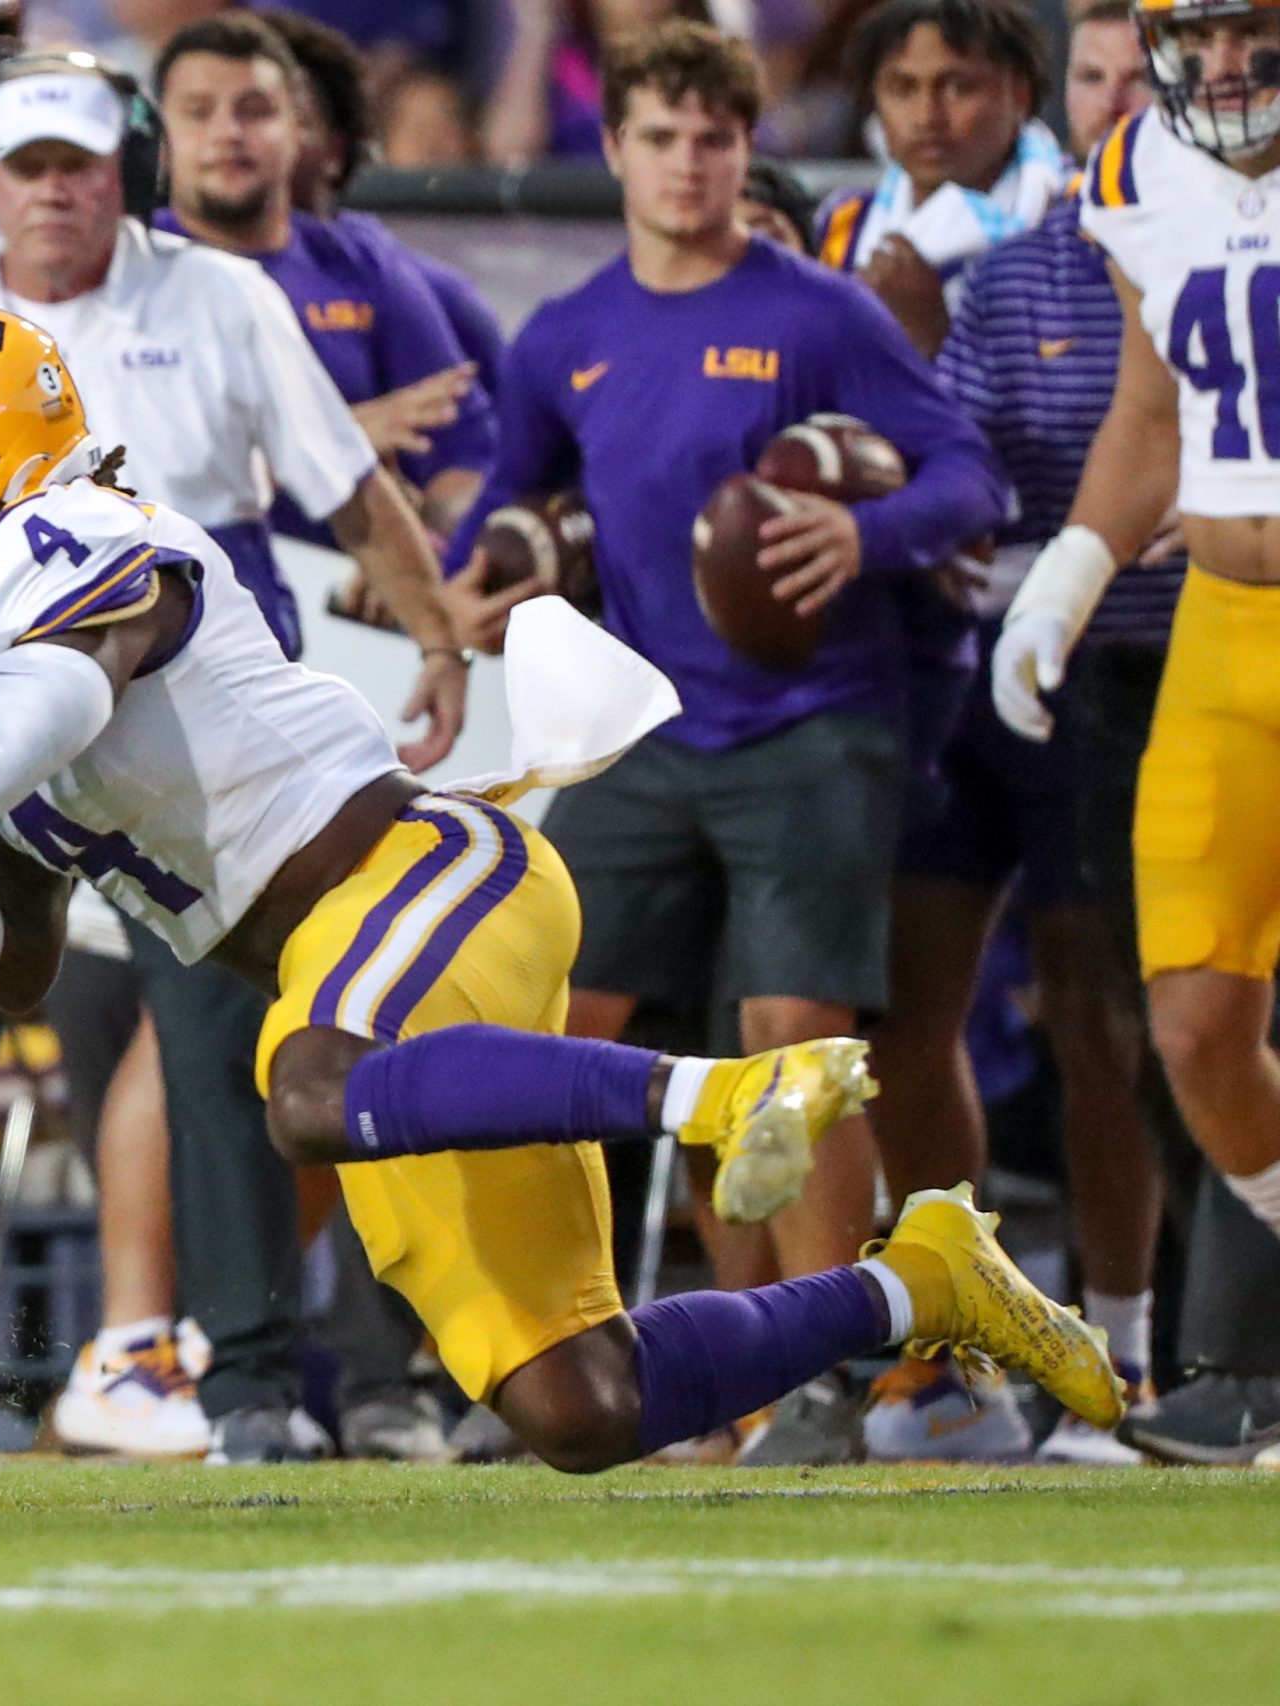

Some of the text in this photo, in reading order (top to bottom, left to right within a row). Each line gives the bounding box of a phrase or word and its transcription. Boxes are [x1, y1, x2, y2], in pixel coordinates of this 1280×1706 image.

[304, 300, 373, 331] LSU
[121, 349, 180, 370] LSU
[703, 346, 780, 382] LSU
[22, 513, 92, 568] 4
[9, 790, 204, 916] 4
